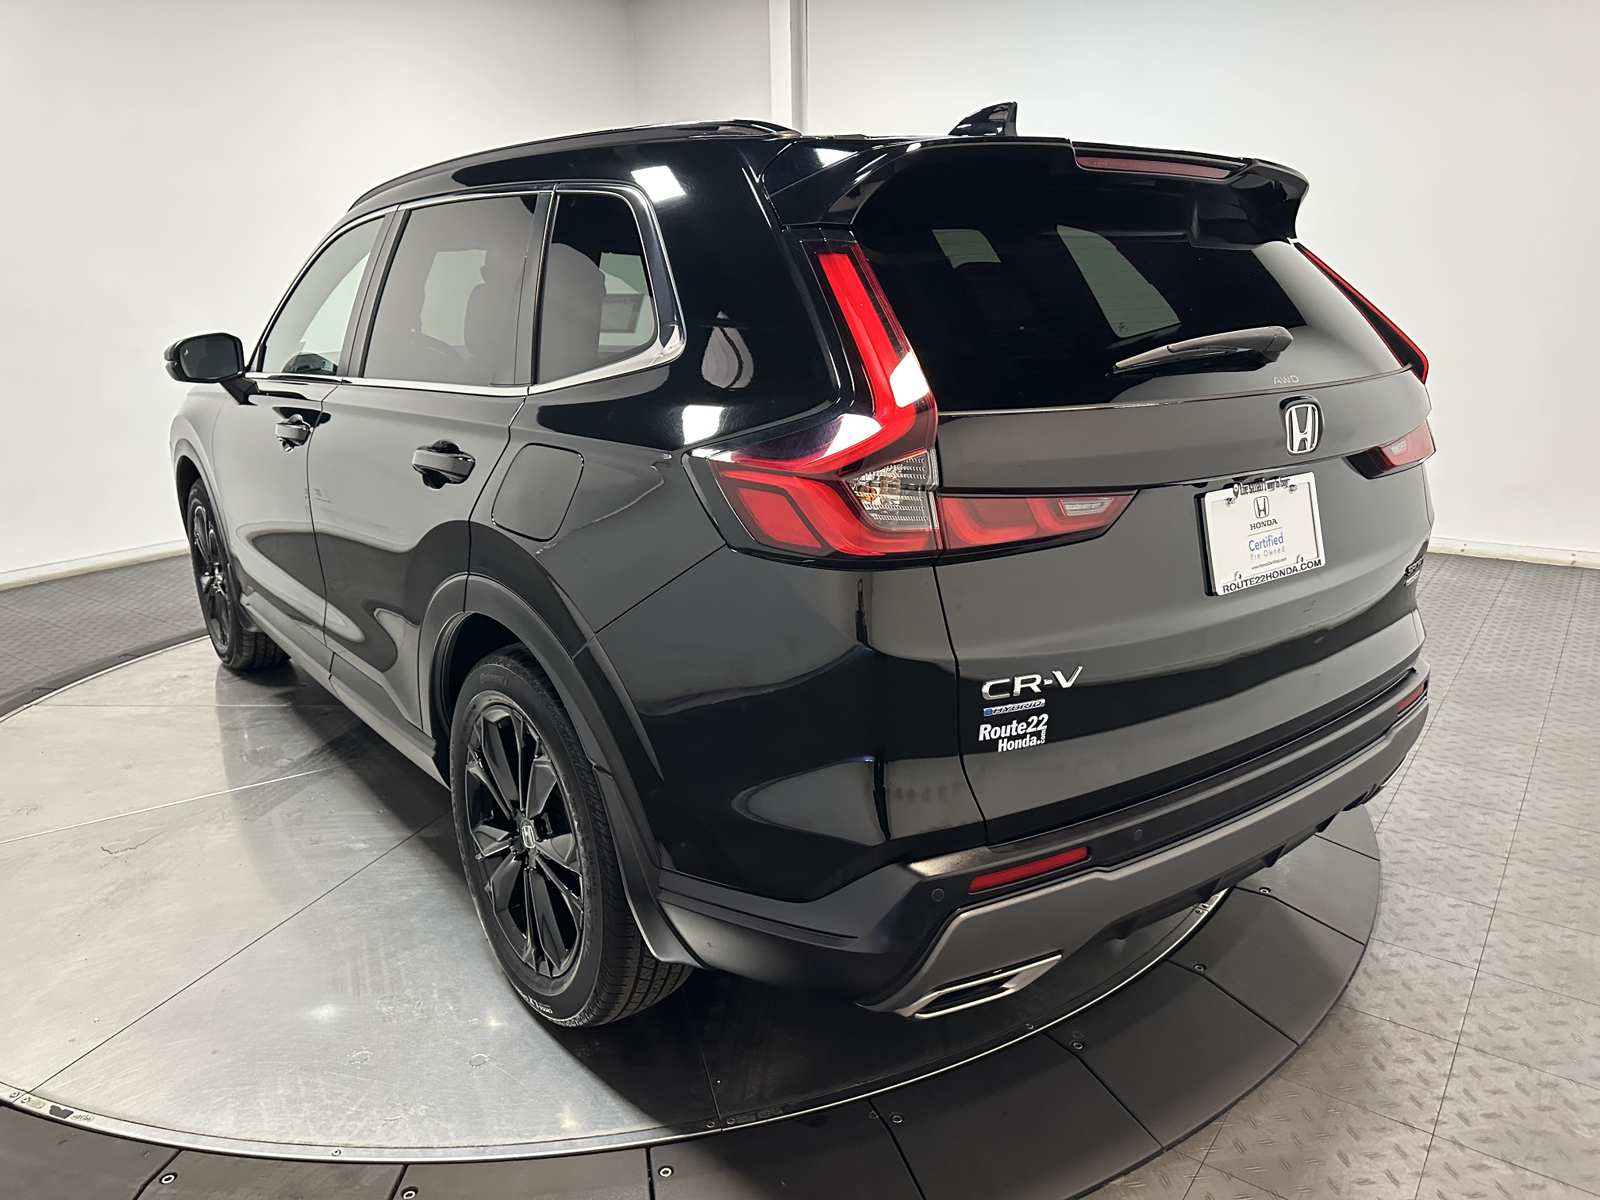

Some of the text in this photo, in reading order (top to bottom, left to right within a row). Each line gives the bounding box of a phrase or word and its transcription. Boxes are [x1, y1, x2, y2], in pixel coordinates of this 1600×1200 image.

[1273, 375, 1299, 384] AWD
[1249, 518, 1278, 530] HONDA
[1248, 531, 1284, 552] Certified
[1250, 545, 1286, 560] Pre-Owned
[1222, 558, 1322, 593] ROUTE22HONDA.COM
[981, 665, 1083, 700] CR-V
